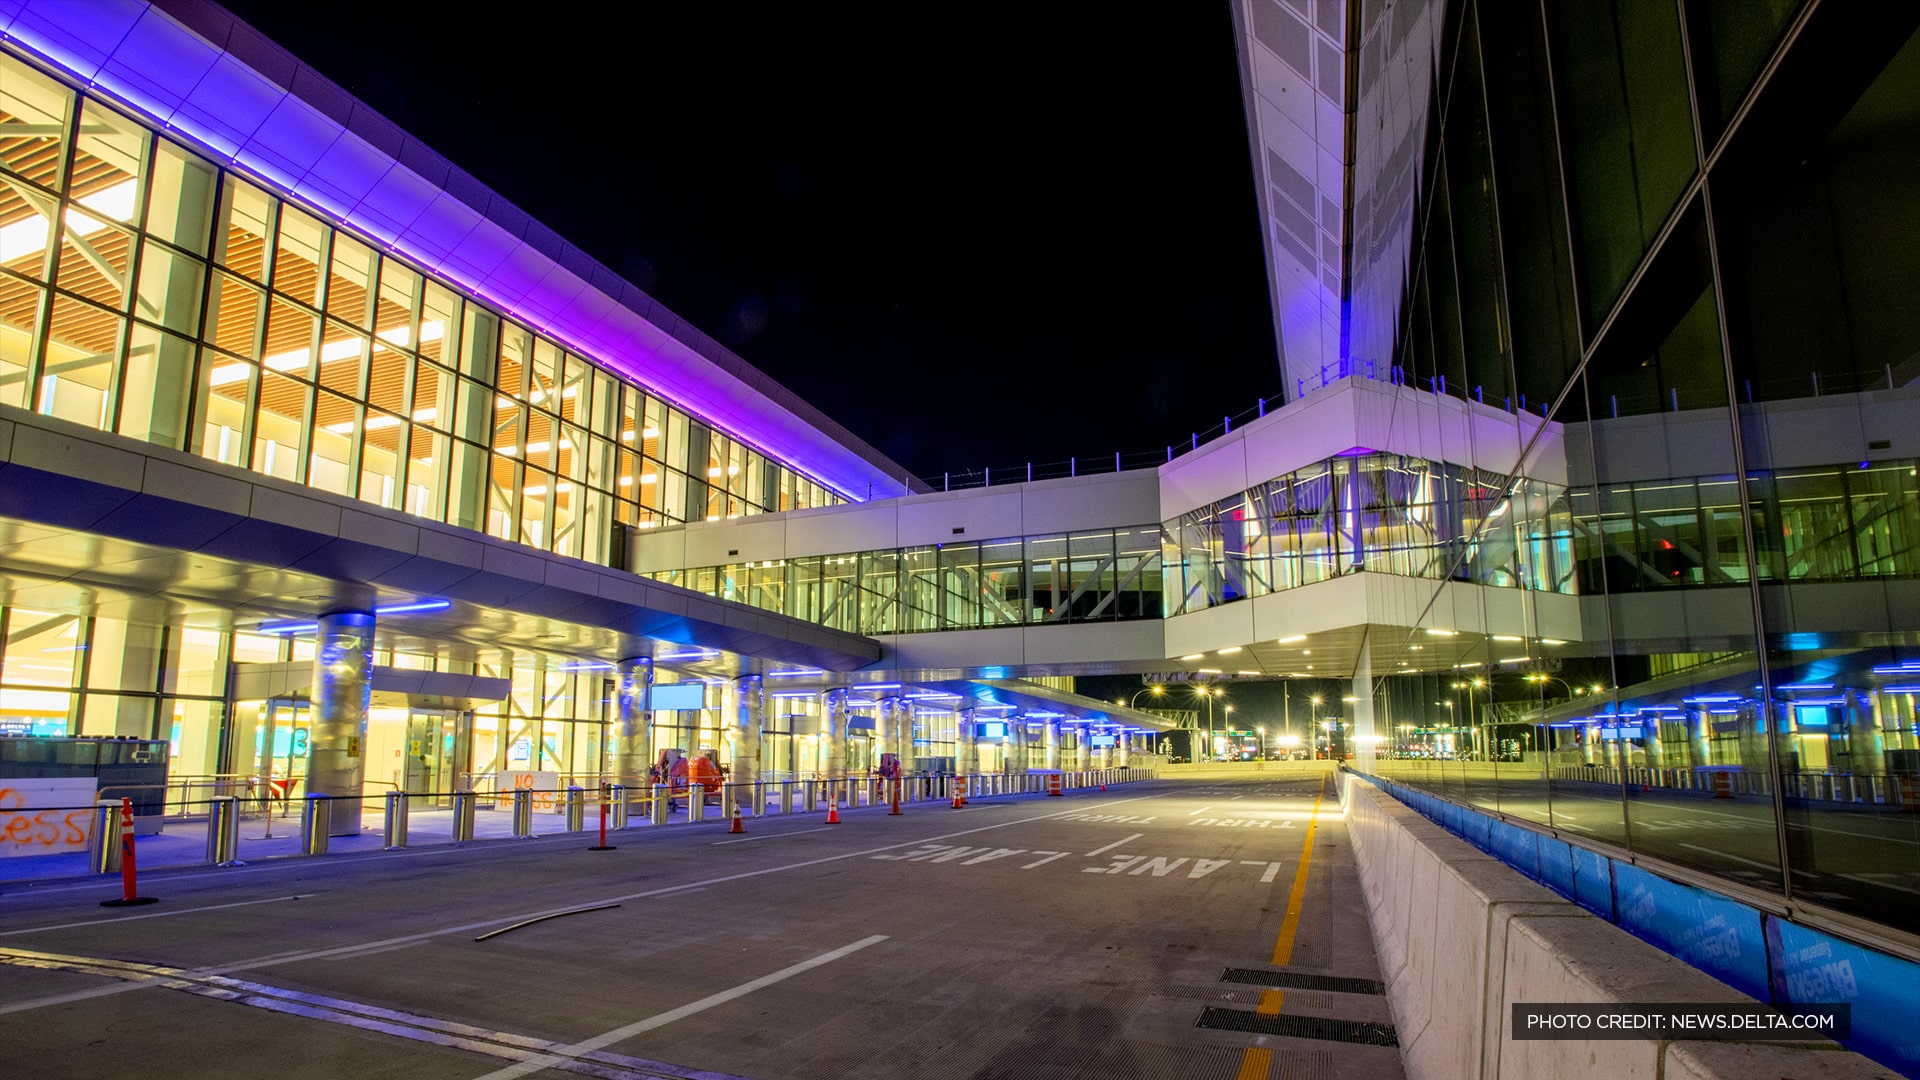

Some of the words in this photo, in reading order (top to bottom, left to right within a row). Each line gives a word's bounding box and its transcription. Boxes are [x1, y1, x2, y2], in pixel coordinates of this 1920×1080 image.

[514, 773, 535, 789] NO
[1053, 813, 1158, 825] THRU
[1188, 817, 1297, 830] THRU
[867, 844, 1072, 870] LANE
[1081, 854, 1282, 883] LANE
